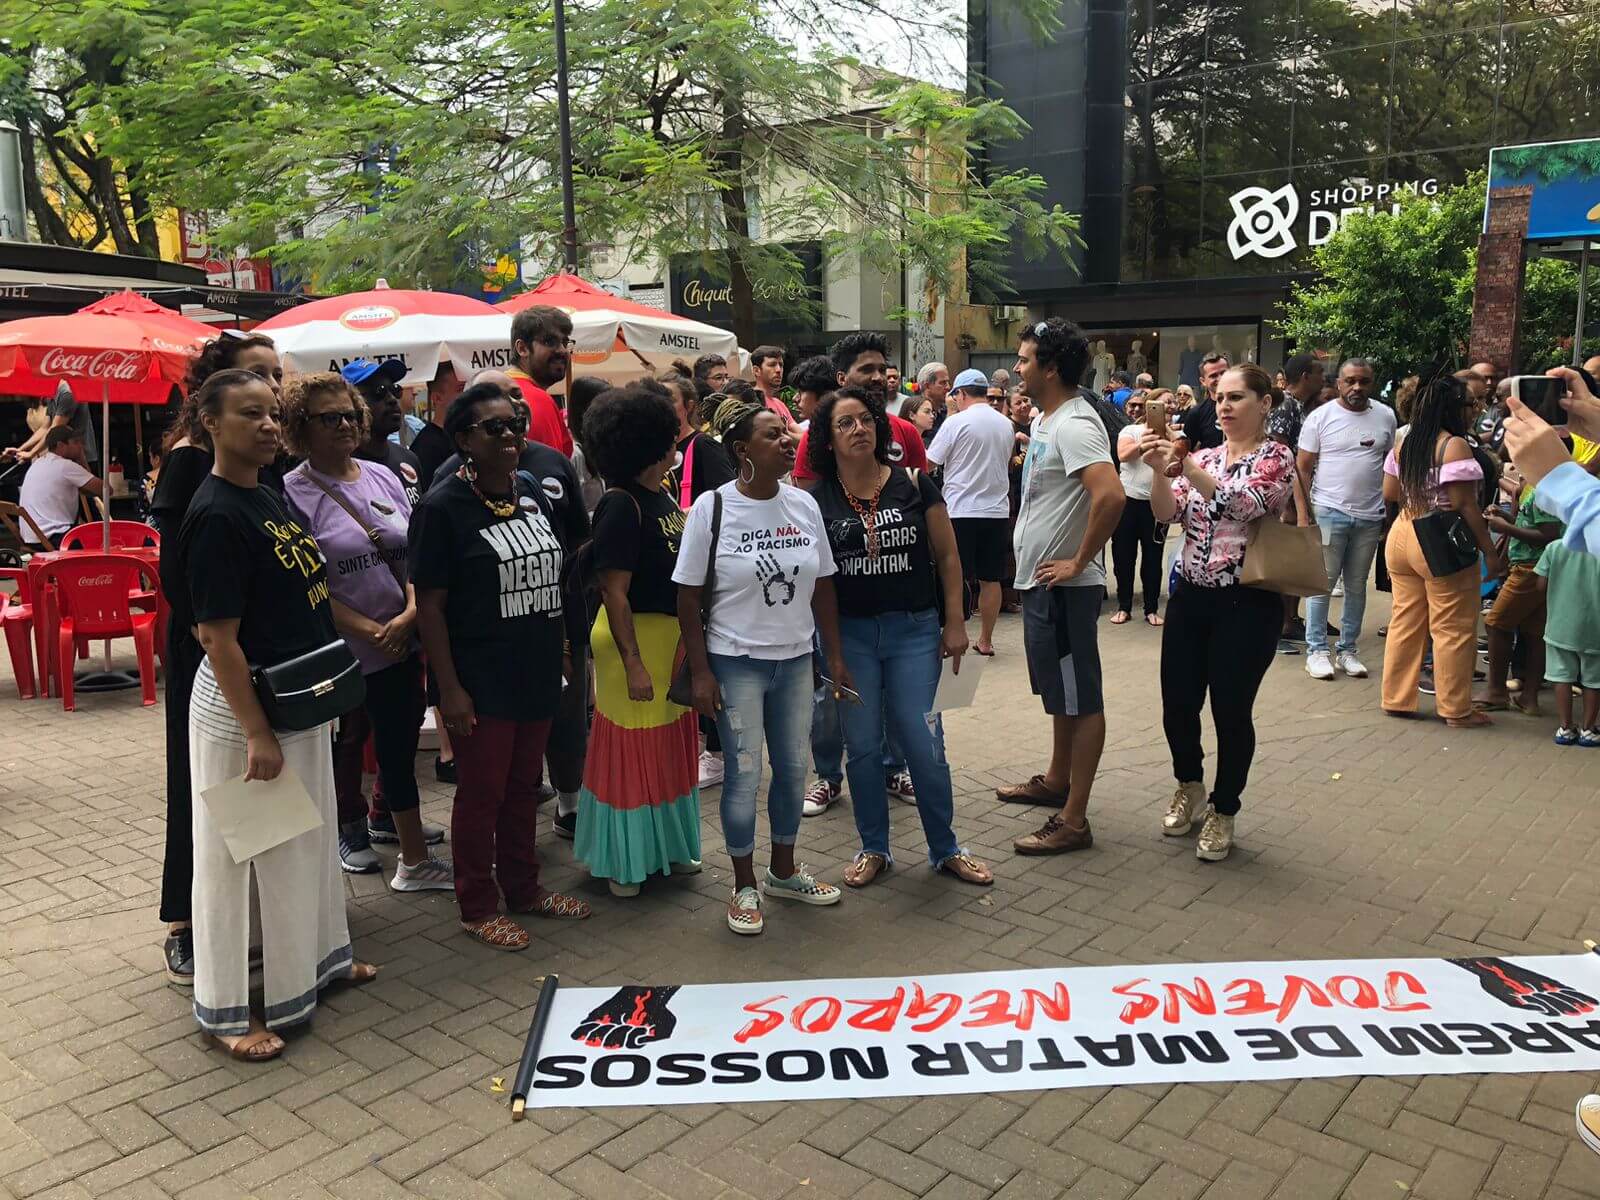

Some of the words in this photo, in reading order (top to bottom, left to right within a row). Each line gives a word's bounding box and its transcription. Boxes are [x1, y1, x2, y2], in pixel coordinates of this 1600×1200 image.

[1310, 179, 1438, 206] SHOPPING
[0, 287, 29, 298] TEL
[207, 291, 239, 304] AMSTEL
[684, 280, 734, 312] Chiquit
[659, 333, 700, 350] AMSTEL
[40, 347, 144, 380] Coca-Cola
[471, 348, 511, 369] AMST
[734, 544, 753, 553] AO
[757, 537, 810, 551] RACISMO
[741, 529, 772, 543] DIGA
[338, 554, 370, 575] SINTE
[840, 552, 913, 576] IMPORTAM.
[1112, 971, 1431, 1025] JOVENS
[733, 981, 1071, 1044] NEGROS
[1235, 1026, 1362, 1060] DE
[1363, 1021, 1600, 1055] AREM
[908, 1031, 1229, 1076] MATAR
[532, 1046, 889, 1089] NOSSOS
